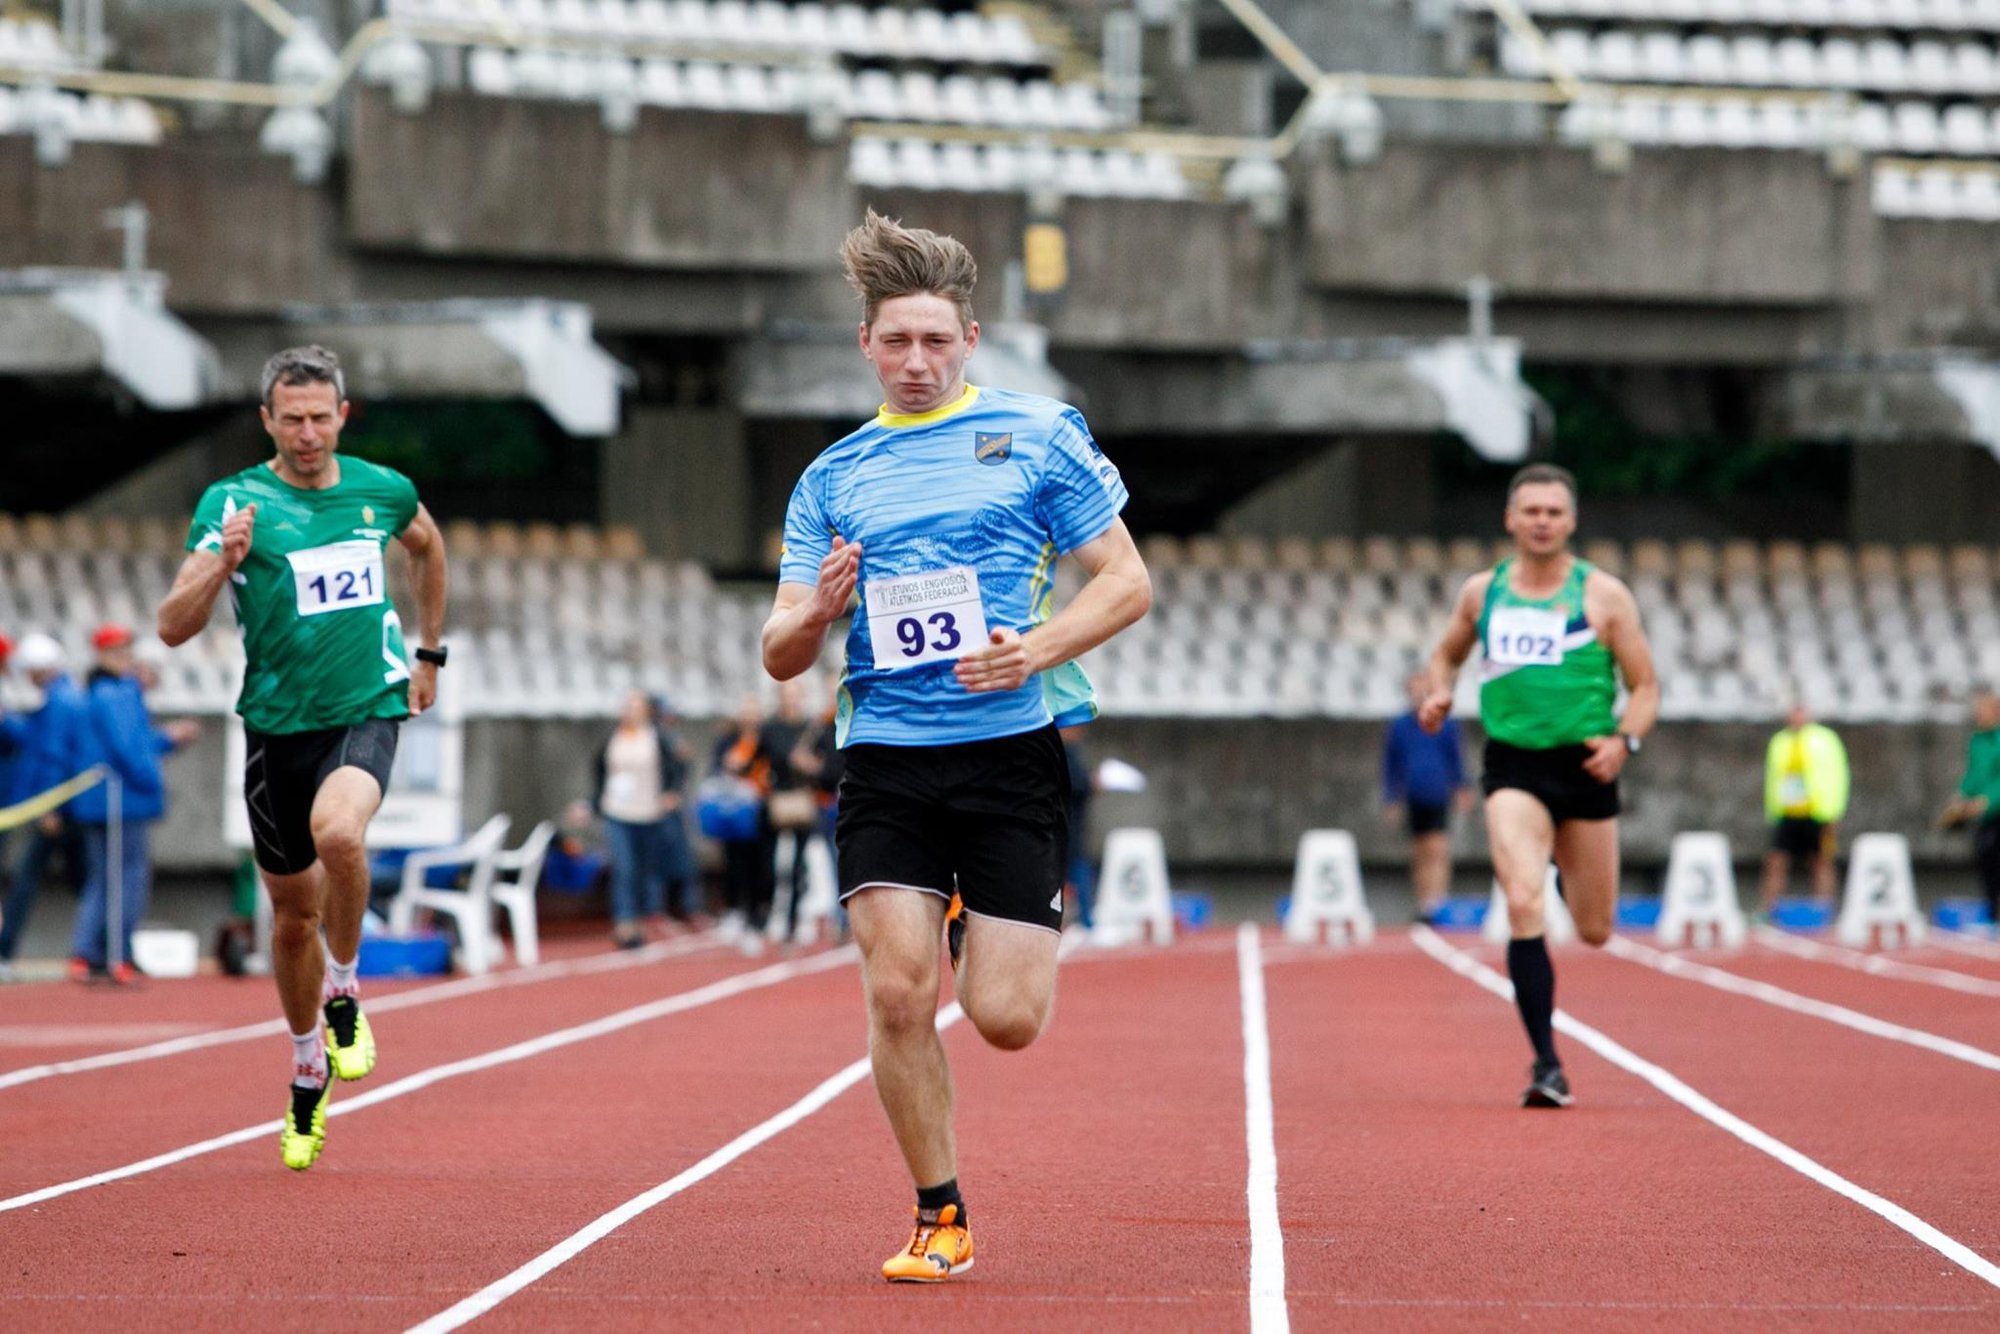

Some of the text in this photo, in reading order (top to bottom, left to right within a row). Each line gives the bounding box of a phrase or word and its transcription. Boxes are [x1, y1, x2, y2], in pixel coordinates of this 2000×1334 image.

[309, 566, 373, 604] 121
[890, 585, 969, 607] ATLETIKOS FEDERACIJA
[896, 611, 962, 657] 93
[1500, 635, 1554, 657] 102
[1866, 861, 1894, 905] 2
